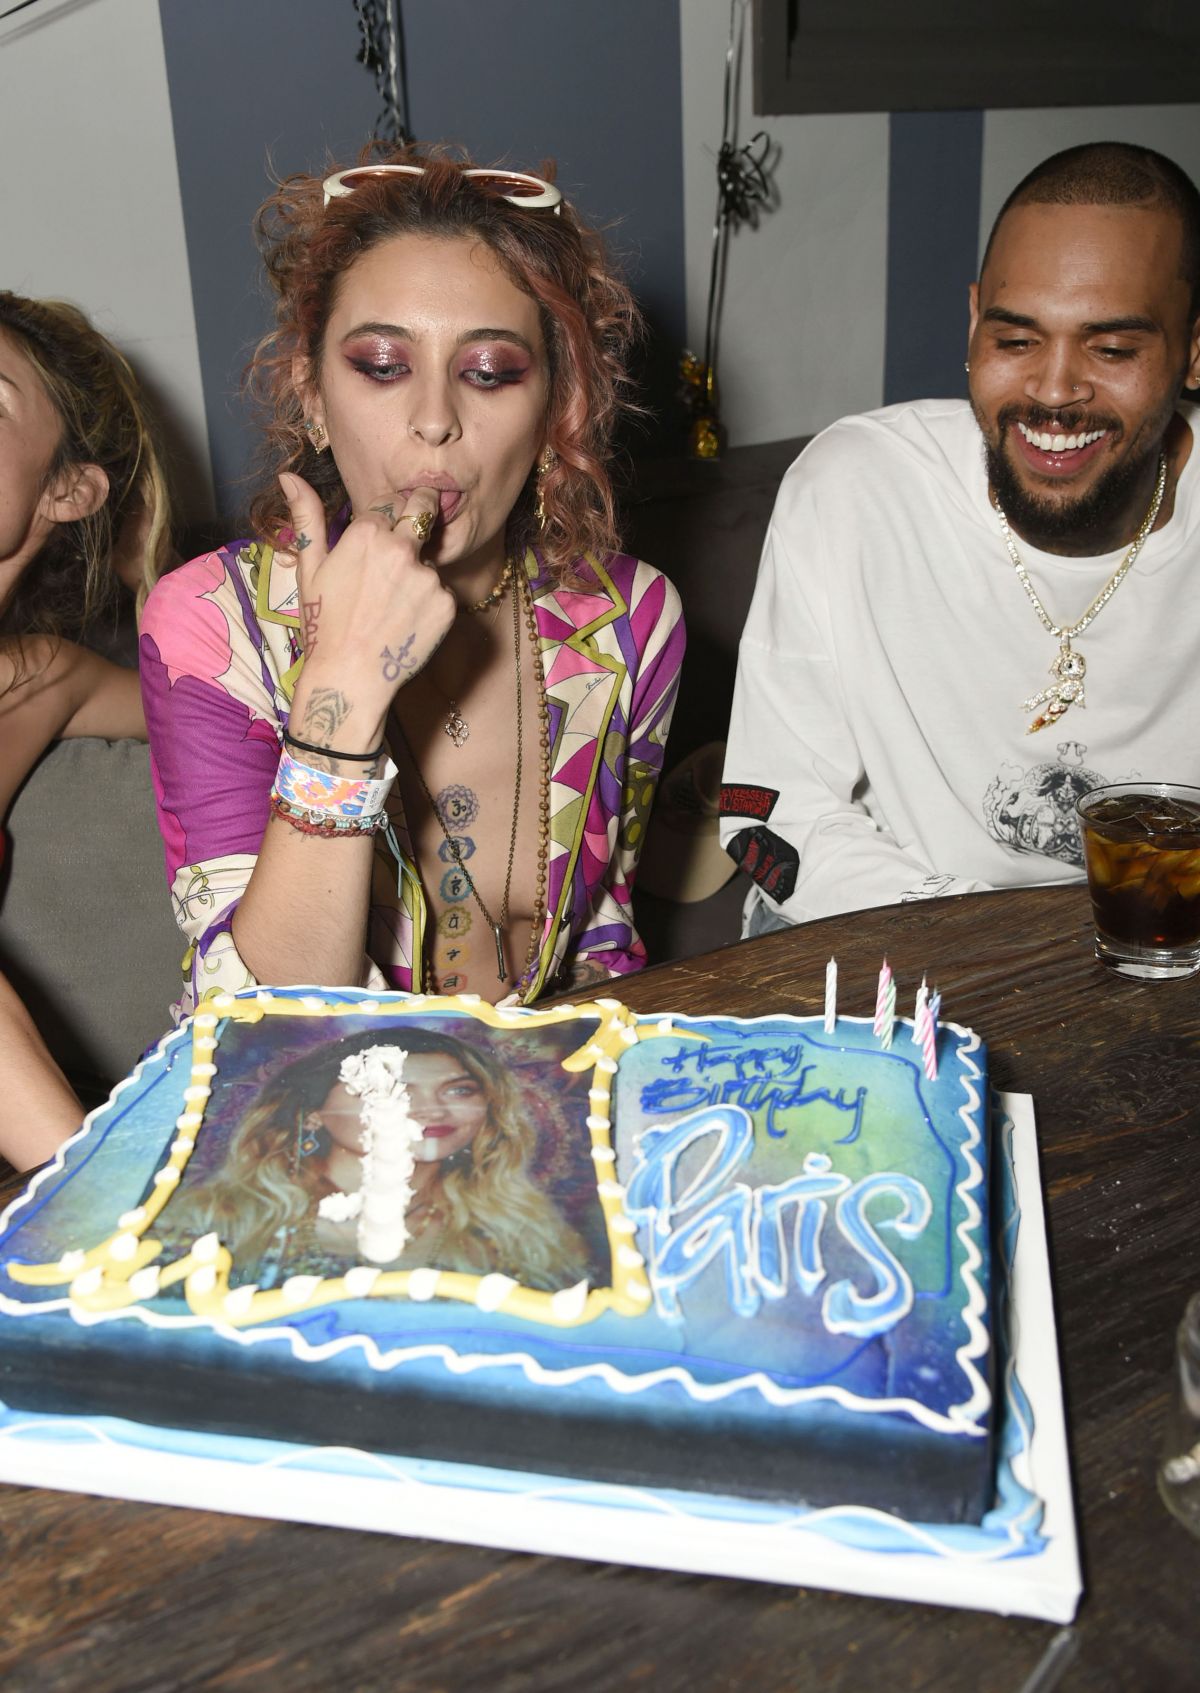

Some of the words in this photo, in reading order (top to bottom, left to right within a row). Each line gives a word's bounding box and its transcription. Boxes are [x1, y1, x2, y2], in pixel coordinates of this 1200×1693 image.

[661, 1042, 804, 1081] Happy
[638, 1064, 868, 1144] Birthday
[623, 1103, 933, 1338] Paris
